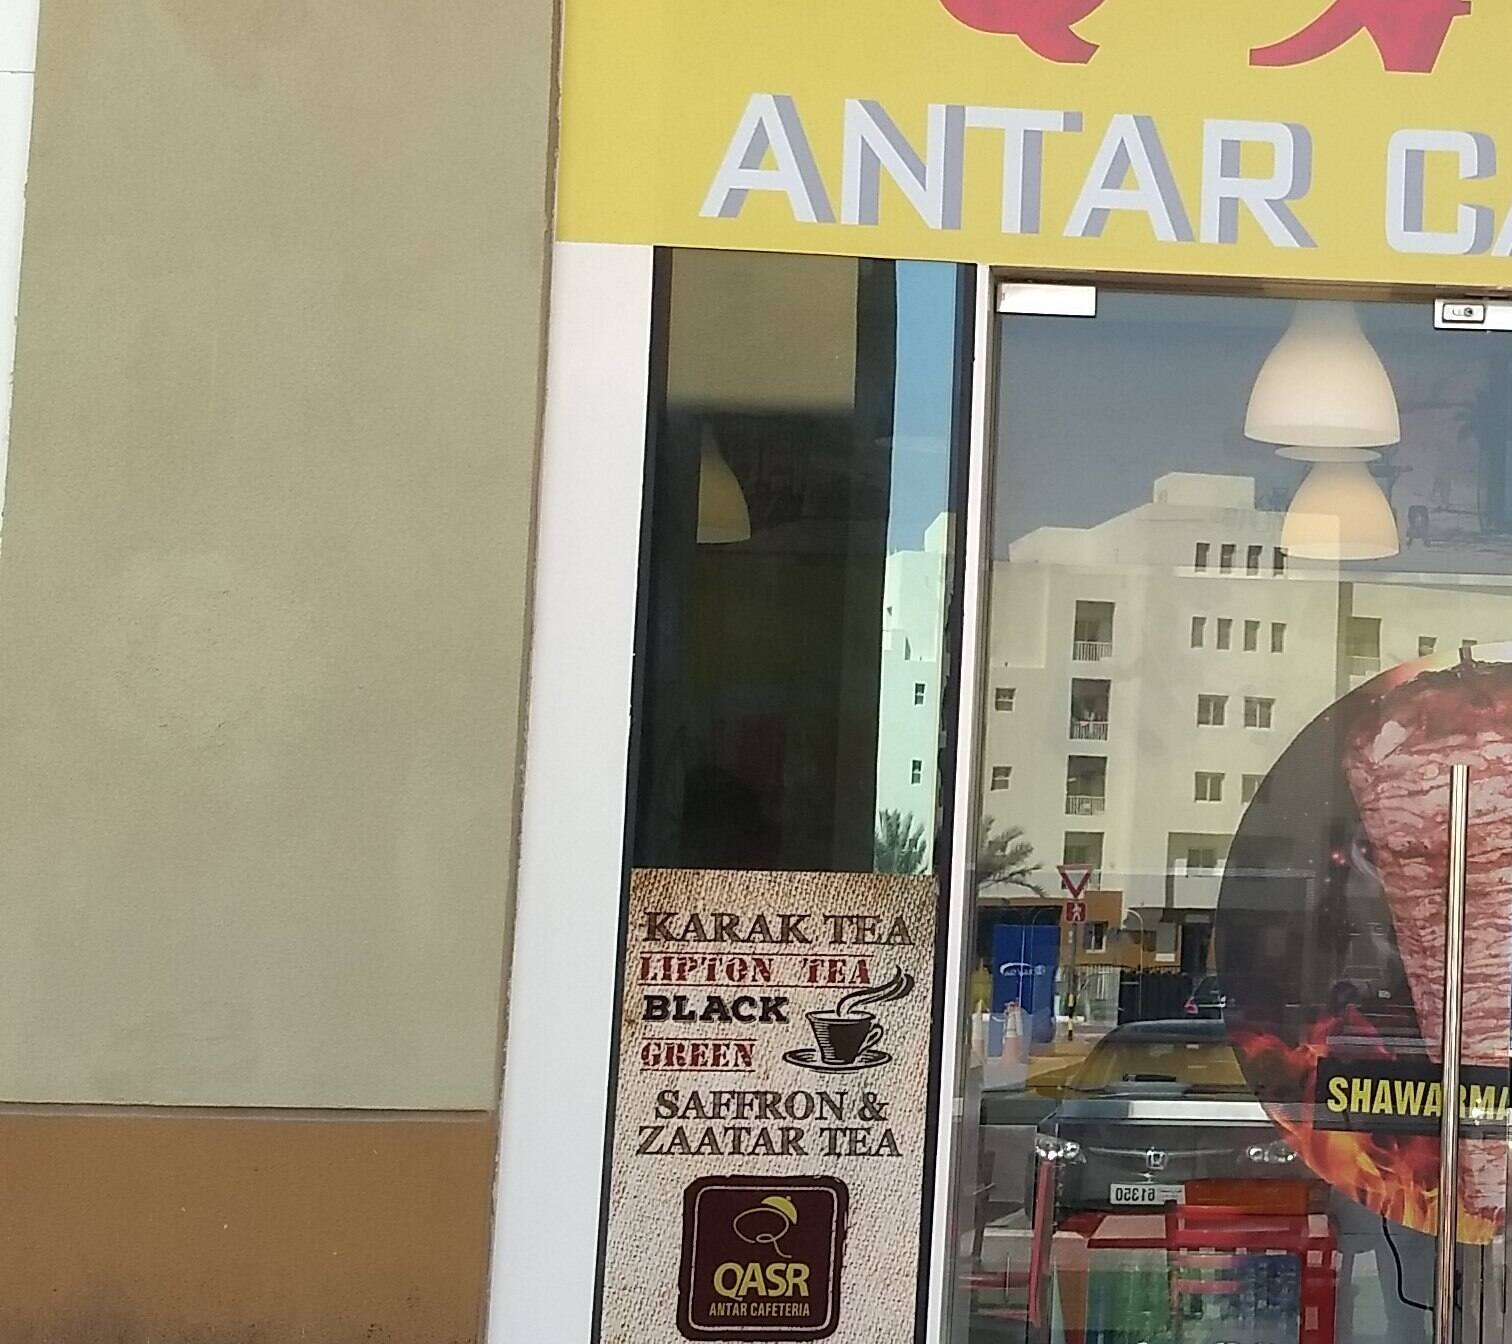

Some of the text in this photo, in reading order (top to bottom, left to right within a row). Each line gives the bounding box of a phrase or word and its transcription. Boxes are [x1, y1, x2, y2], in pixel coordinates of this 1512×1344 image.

[700, 93, 1318, 248] ANTAR
[643, 912, 915, 945] KARAK TEA
[640, 956, 871, 984] LIPTON TEA
[642, 994, 789, 1024] BLACK
[640, 1041, 755, 1067] GREEN
[654, 1090, 888, 1121] SAFFRON &
[636, 1125, 902, 1156] ZAATAR TEA
[713, 1262, 810, 1301] QASR
[709, 1302, 810, 1317] ANTAR CAFETERIA
